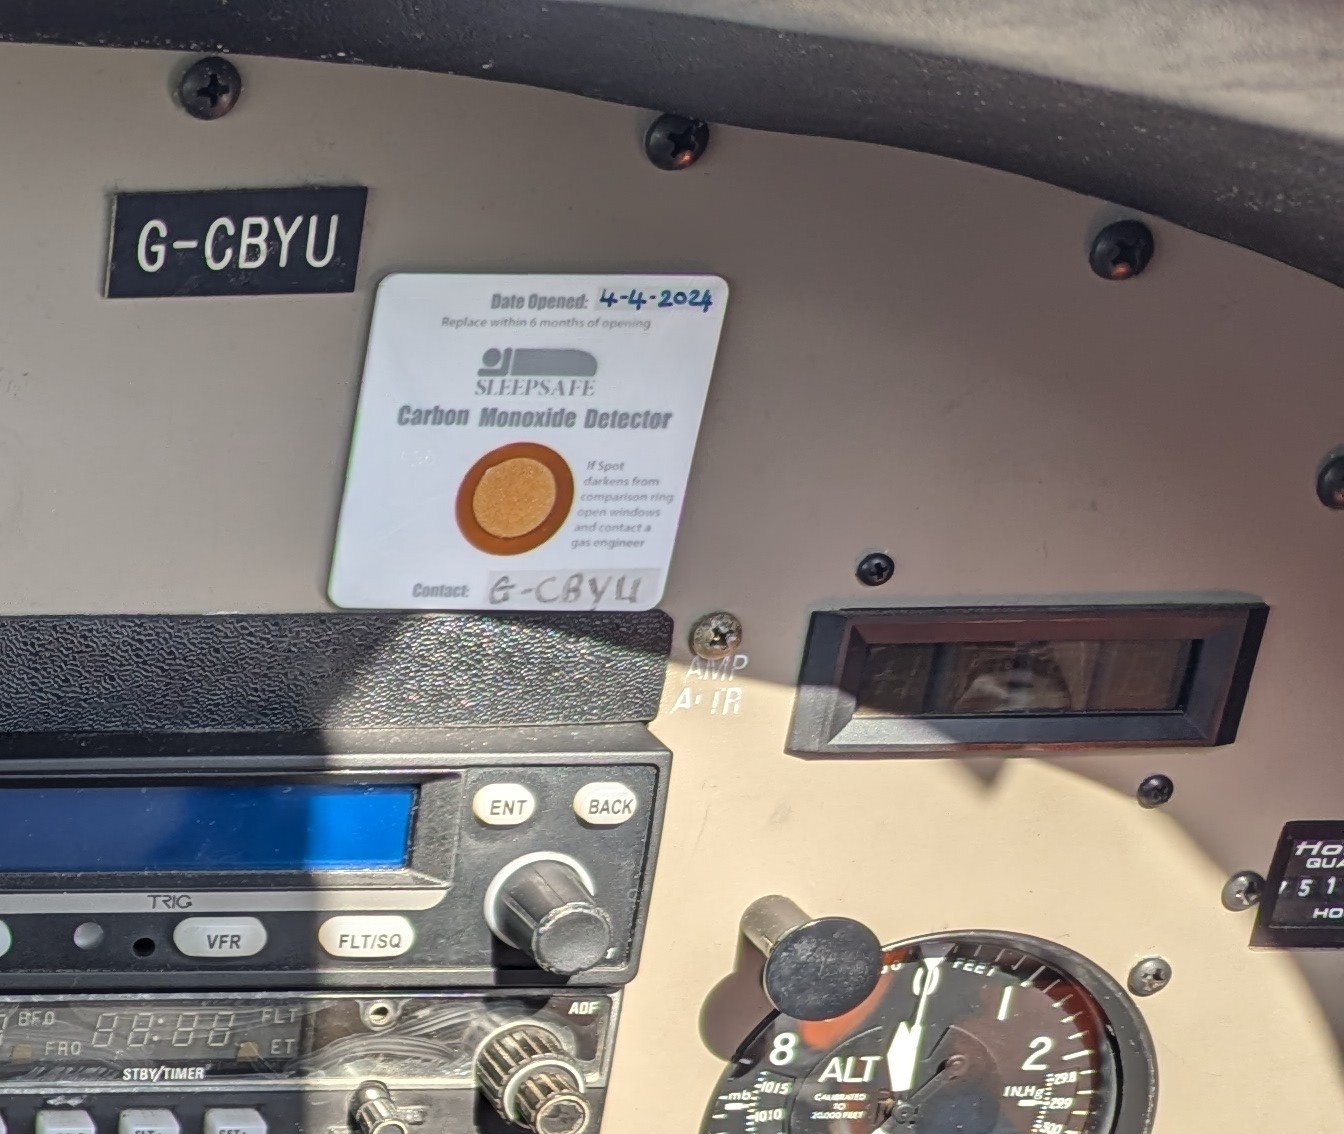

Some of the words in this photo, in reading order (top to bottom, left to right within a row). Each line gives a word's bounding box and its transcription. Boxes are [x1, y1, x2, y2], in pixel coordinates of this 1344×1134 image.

[137, 214, 339, 273] G-CBYU
[491, 294, 524, 310] Date
[528, 294, 588, 312] Opened:
[599, 288, 714, 313] 4-4-2024
[441, 317, 487, 330] Replace
[491, 317, 527, 329] within
[531, 318, 538, 329] 6
[540, 317, 583, 329] months
[586, 317, 600, 329] of
[602, 318, 651, 332] opening
[475, 379, 596, 397] SLEEPSAFE
[397, 404, 469, 427] Carbon
[478, 407, 576, 428] Monoxide
[584, 408, 672, 430] Detector
[587, 461, 596, 470] If
[598, 461, 624, 472] Spot
[584, 477, 629, 486] darkens
[632, 477, 660, 486] from
[577, 509, 607, 518] open
[610, 508, 660, 517] windows
[571, 539, 591, 549] gas
[594, 538, 645, 549] engineer
[412, 582, 470, 599] Contact:
[488, 574, 643, 611] G-CBYU
[489, 799, 527, 816] ENT
[588, 798, 633, 815] BACK
[206, 933, 242, 950] VFR
[338, 933, 402, 950] FLT/SQ
[122, 1066, 204, 1082] STBY/TIMER
[818, 1055, 882, 1084] ALT
